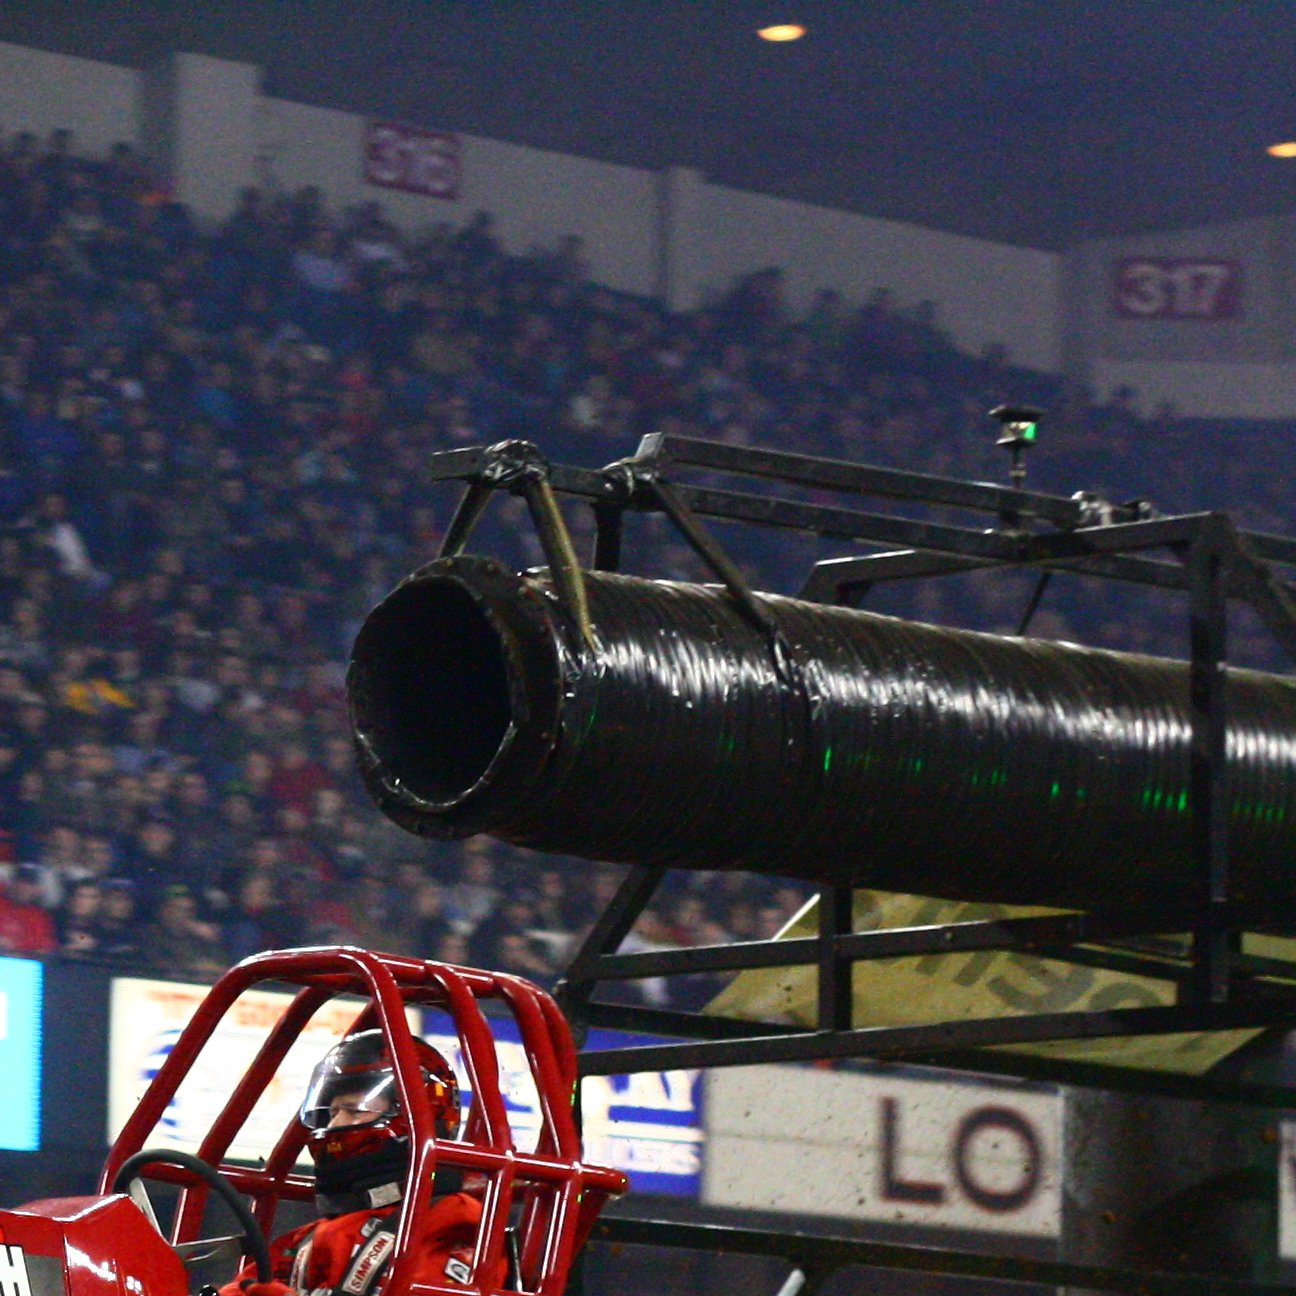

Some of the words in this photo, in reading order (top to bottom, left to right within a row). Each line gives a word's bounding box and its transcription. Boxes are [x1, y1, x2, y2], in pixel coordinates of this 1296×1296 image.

[1124, 264, 1228, 314] 317
[878, 1096, 1045, 1215] LO
[349, 1237, 390, 1291] SIMPSON
